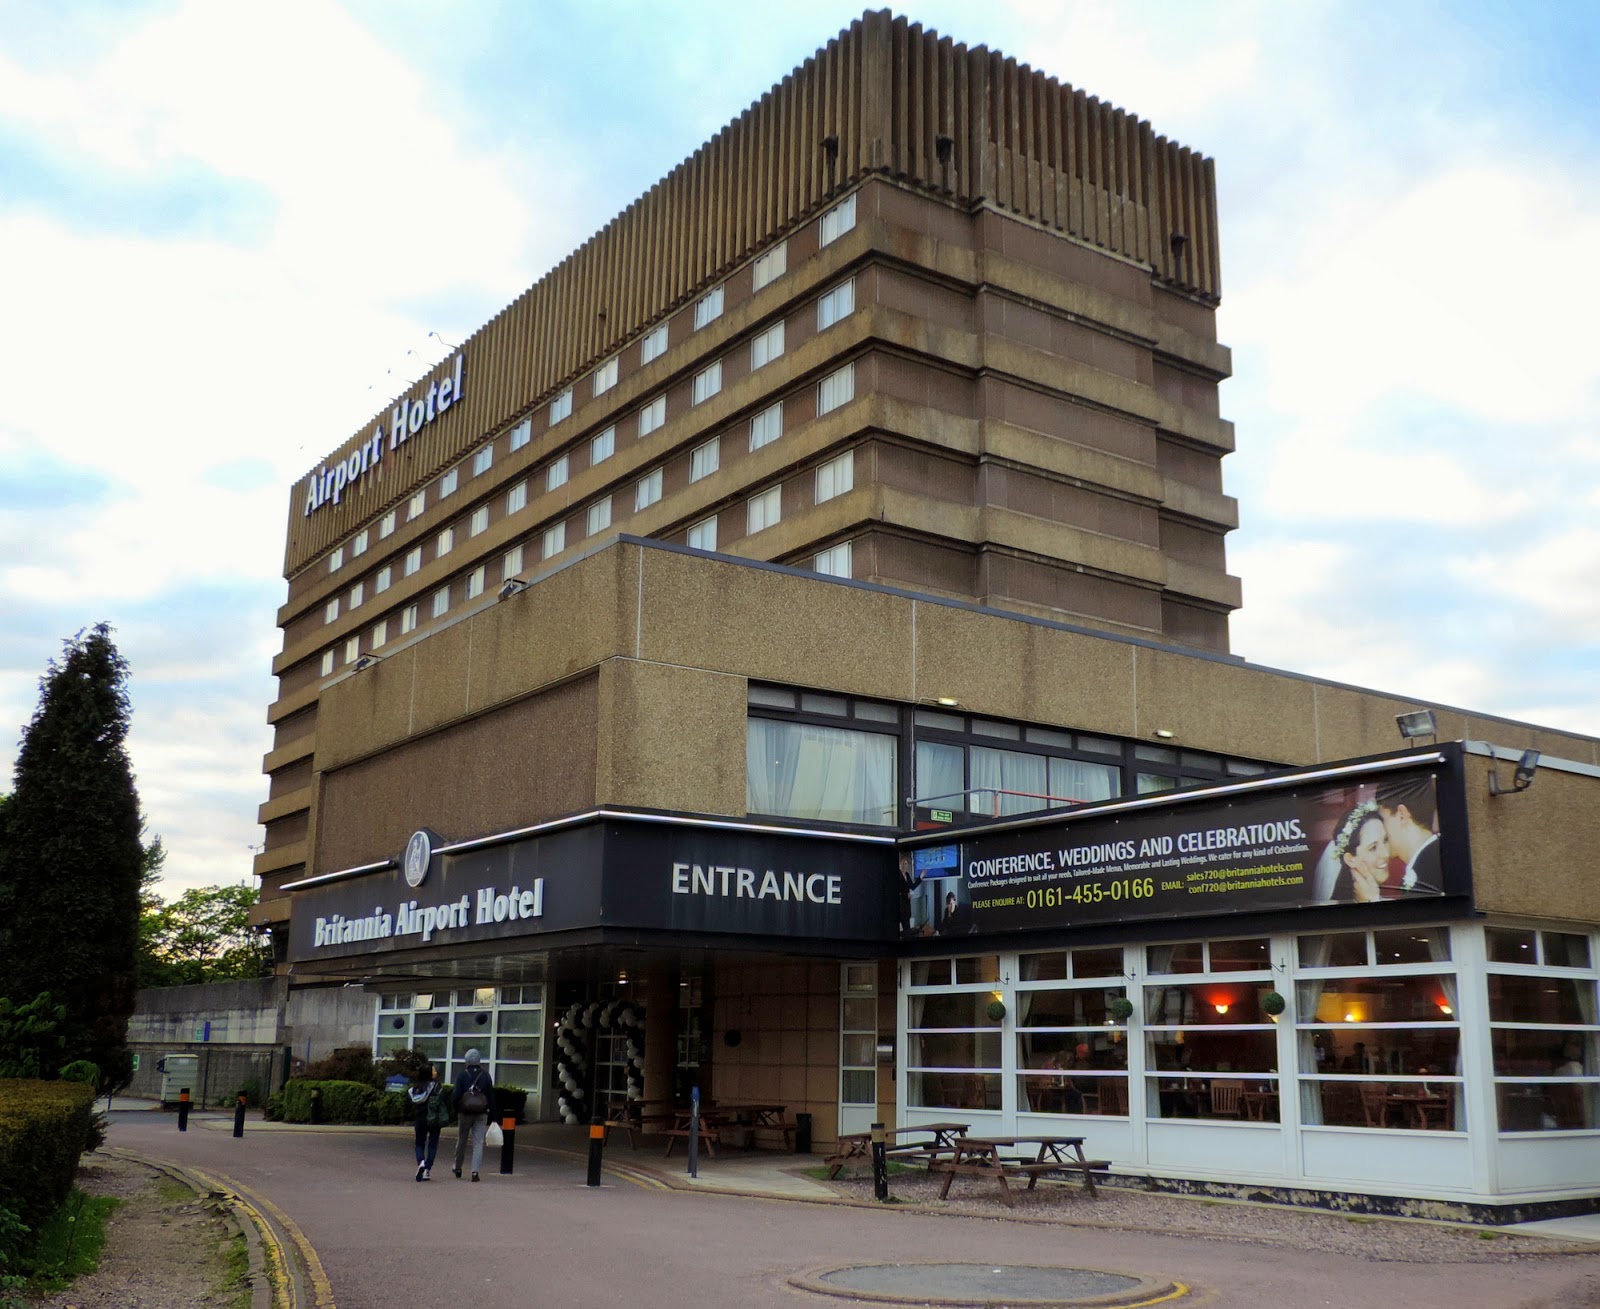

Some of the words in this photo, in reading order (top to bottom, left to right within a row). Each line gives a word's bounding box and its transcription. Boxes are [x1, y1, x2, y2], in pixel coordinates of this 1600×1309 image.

[304, 424, 384, 518] Airport
[390, 353, 465, 451] Hotel
[969, 851, 1055, 878] CONFERENCE,
[1058, 840, 1136, 867] WEDDINGS
[1139, 836, 1173, 858] AND
[1177, 819, 1307, 853] CELEBRATIONS.
[1008, 875, 1027, 886] designed
[1032, 873, 1041, 882] suit
[1048, 872, 1059, 881] your
[1151, 859, 1162, 868] and
[1161, 857, 1180, 868] Lasting
[1180, 854, 1208, 865] Weddings.
[1207, 853, 1218, 862] We
[1218, 852, 1232, 861] cater
[1232, 850, 1242, 859] for
[1242, 849, 1253, 859] any
[1253, 847, 1266, 857] kind
[1266, 846, 1274, 855] of
[672, 862, 842, 905] ENTRANCE
[1161, 881, 1185, 891] EMAIL:
[1186, 862, 1303, 882] sales720@britanniahotels.com
[1188, 875, 1304, 895] conf720@britanniahotels.com
[313, 906, 393, 947] Britannia
[394, 894, 470, 942] Airport
[475, 877, 544, 925] Hotel
[972, 899, 991, 909] PLEASE
[991, 897, 1016, 907] ENQUIRE
[1016, 896, 1026, 905] AT:
[1026, 877, 1155, 909] 0161-455-0166
